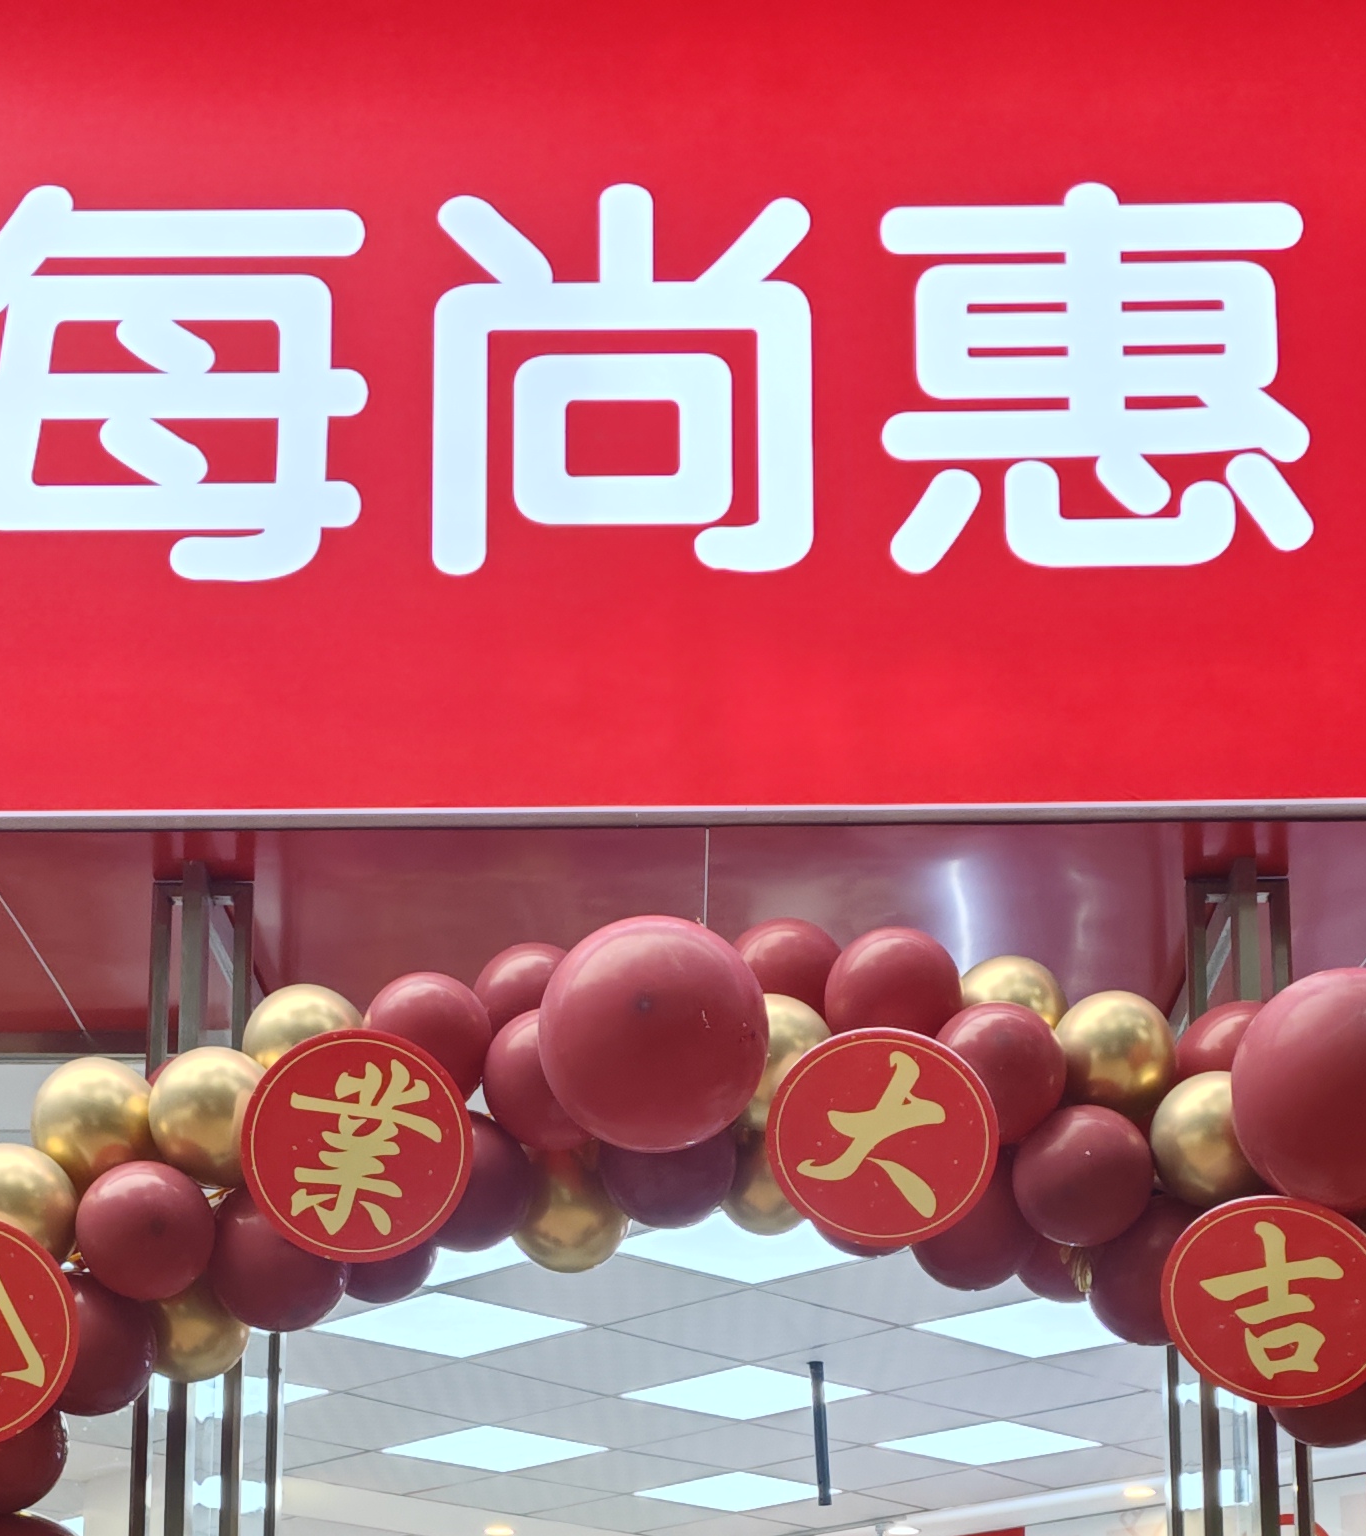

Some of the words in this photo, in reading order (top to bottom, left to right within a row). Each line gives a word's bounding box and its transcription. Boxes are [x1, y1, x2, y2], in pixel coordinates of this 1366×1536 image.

[290, 1058, 439, 1236] 業
[795, 1050, 946, 1220] 大
[1201, 1221, 1344, 1382] 吉
